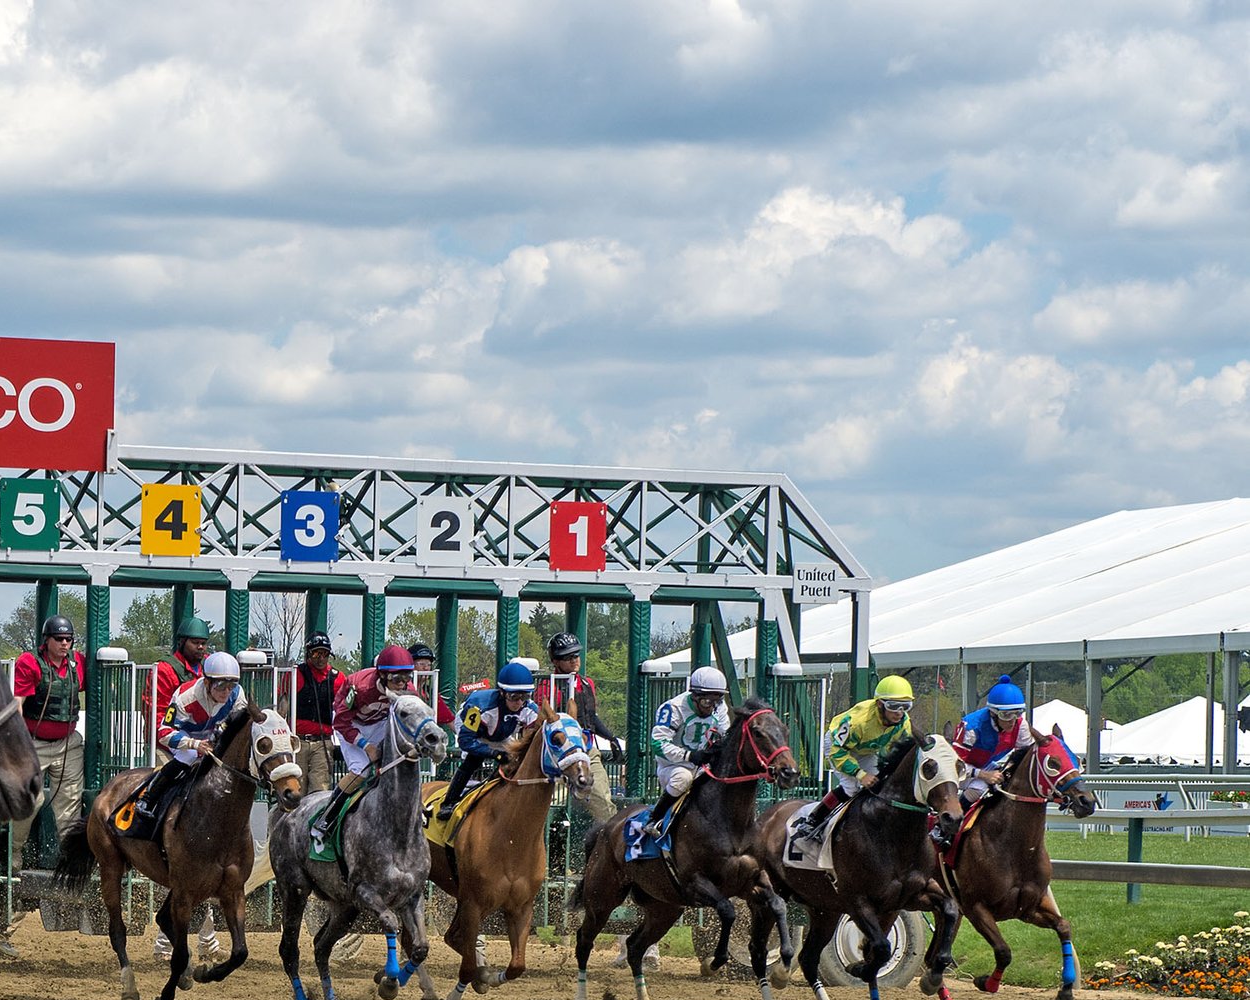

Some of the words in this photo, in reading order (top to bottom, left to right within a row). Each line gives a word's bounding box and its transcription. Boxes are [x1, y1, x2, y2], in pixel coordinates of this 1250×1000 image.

[11, 493, 46, 536] 5
[154, 499, 188, 540] 4
[294, 504, 326, 547] 3
[430, 510, 461, 551] 2
[568, 515, 589, 556] 1
[797, 567, 836, 582] United
[800, 585, 831, 597] Puett
[462, 682, 486, 691] TUNNEL
[165, 707, 175, 723] 6
[469, 713, 477, 726] 4
[659, 709, 670, 723] 3
[838, 726, 848, 741] 2
